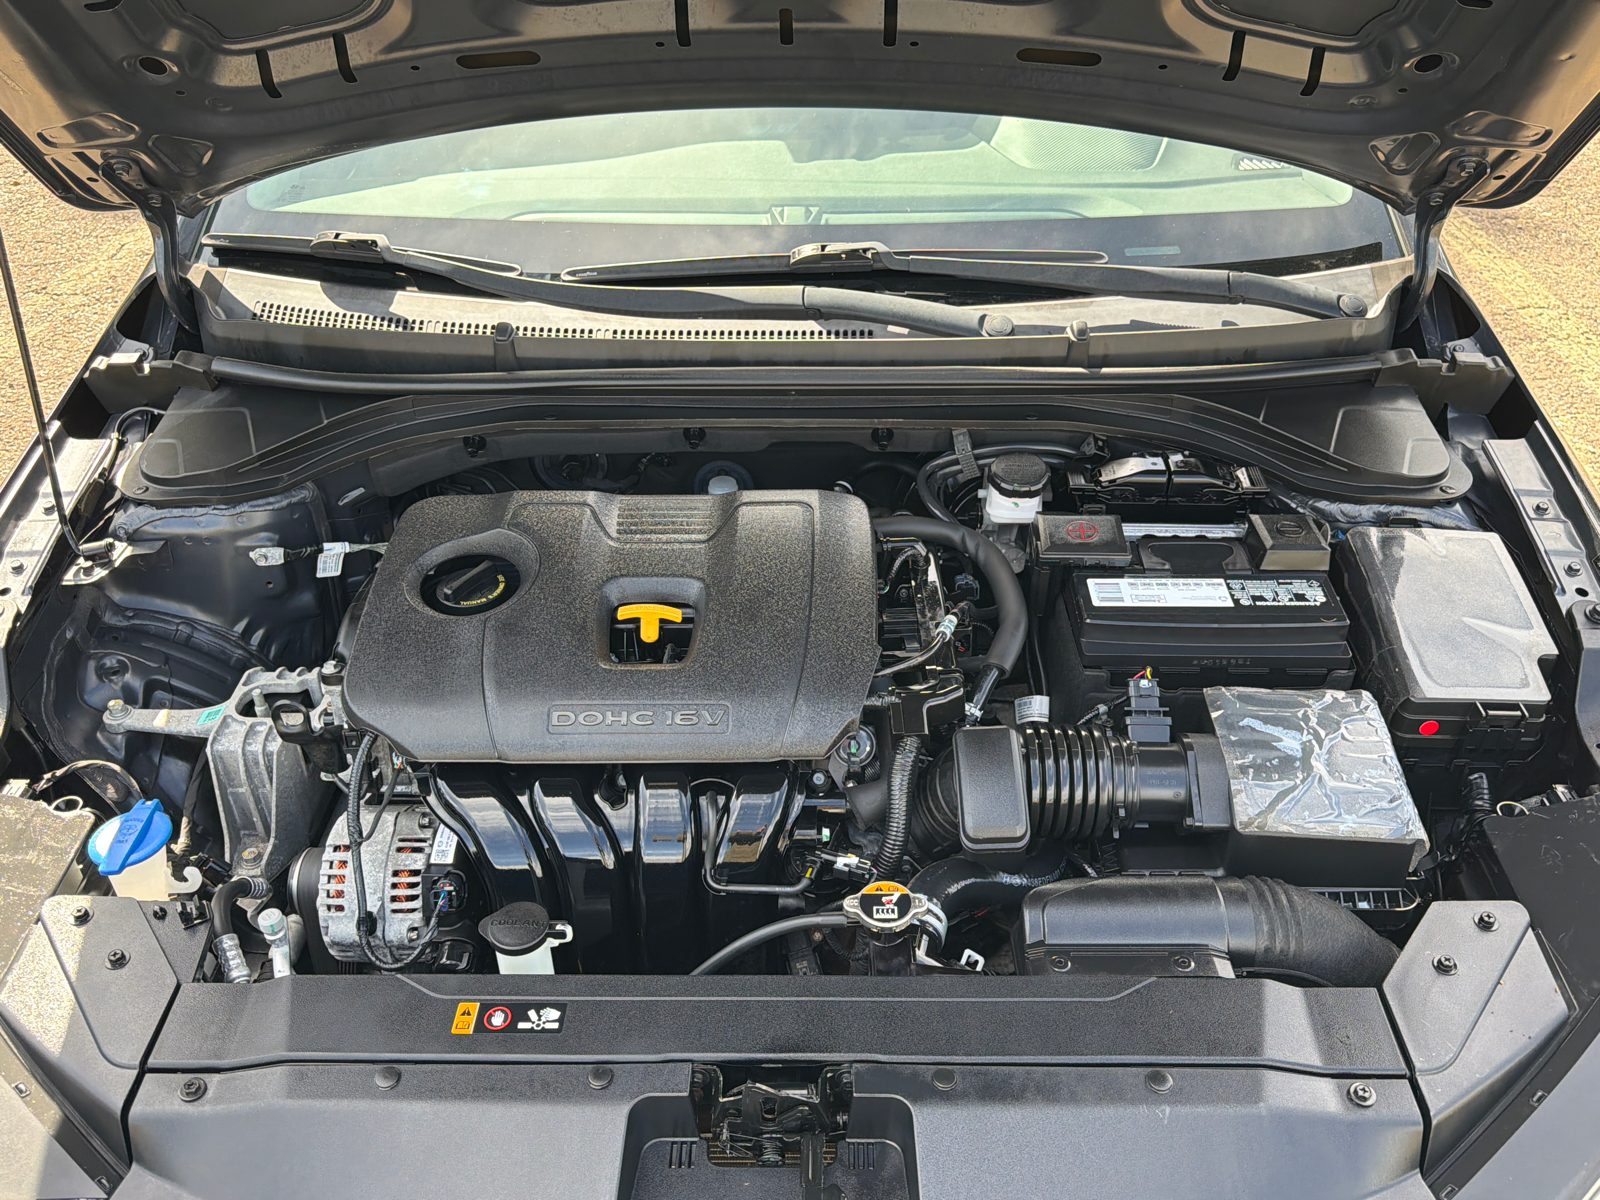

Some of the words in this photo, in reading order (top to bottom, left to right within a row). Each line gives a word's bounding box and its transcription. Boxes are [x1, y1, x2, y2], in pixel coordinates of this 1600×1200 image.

[497, 574, 505, 582] SEE
[460, 597, 487, 605] MANUAL
[551, 710, 654, 726] DOHC
[665, 710, 726, 726] 16V
[490, 919, 547, 928] COOLANT
